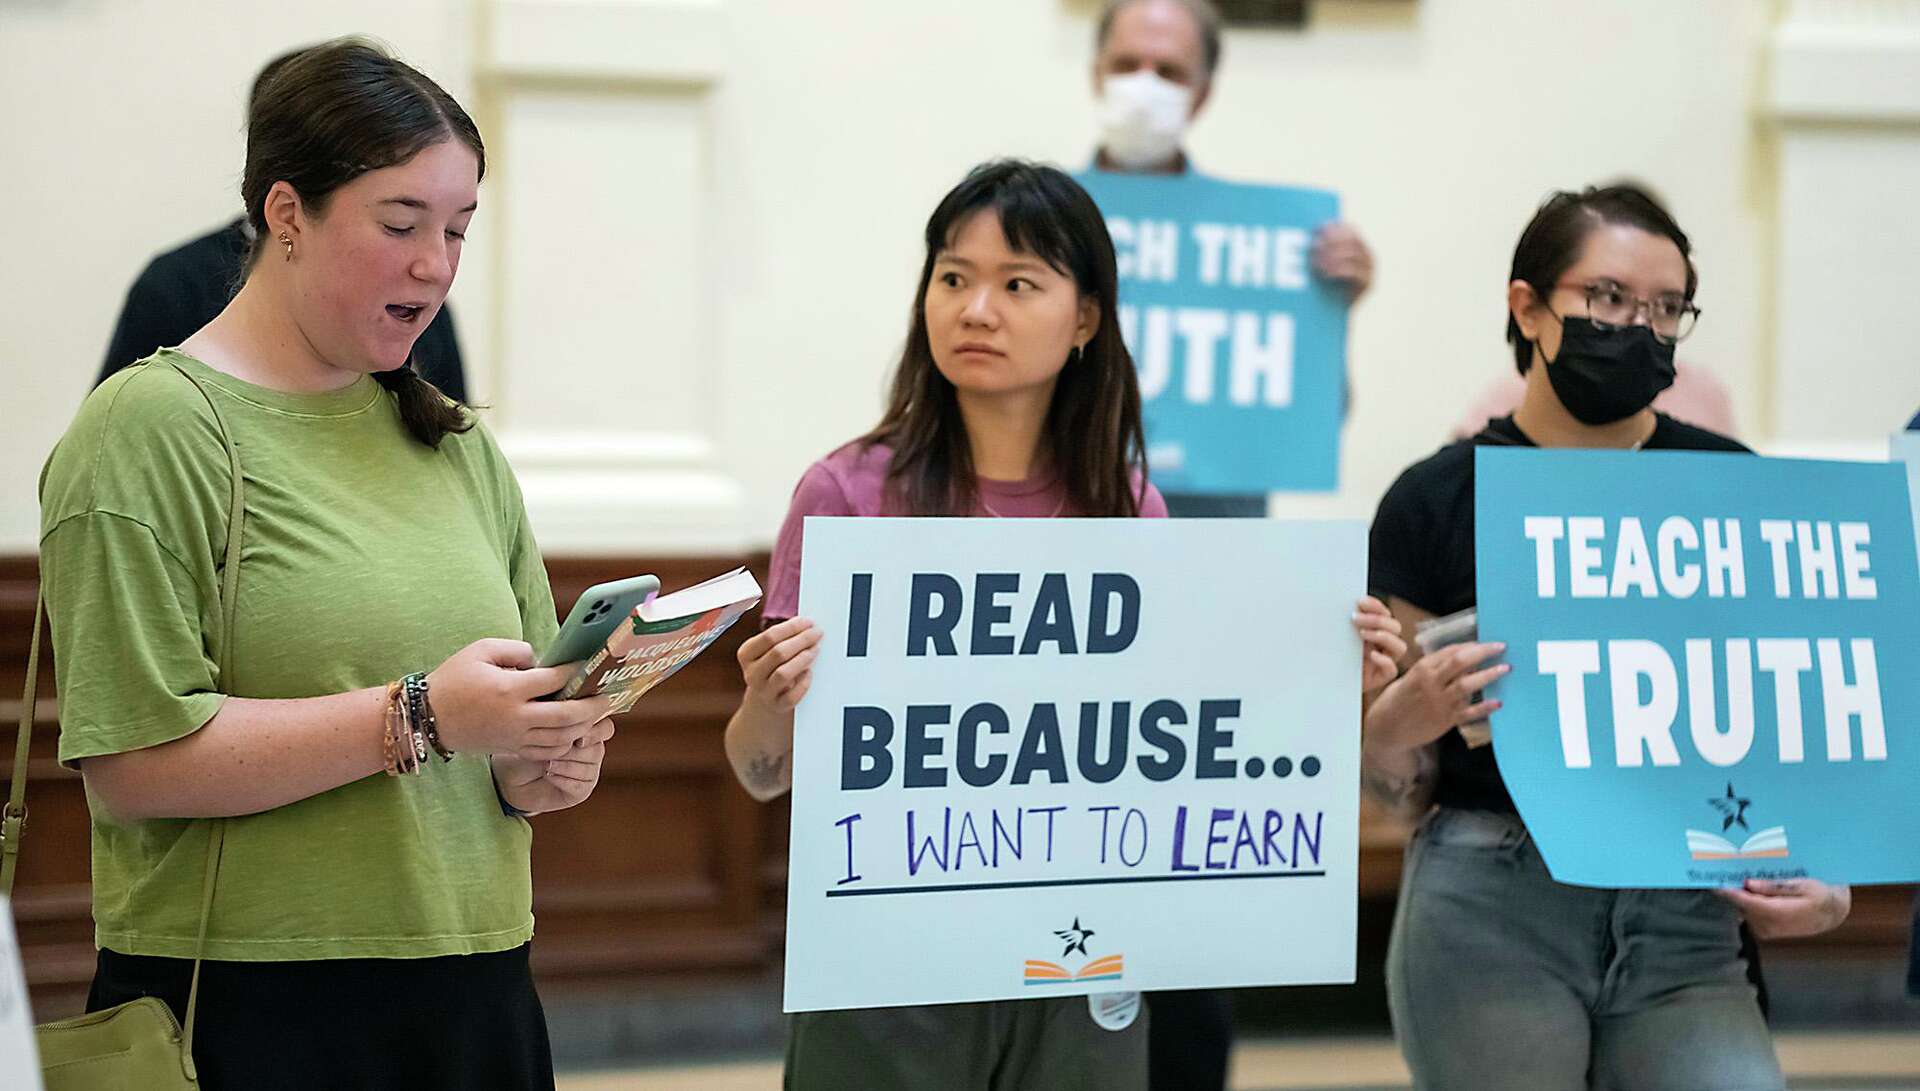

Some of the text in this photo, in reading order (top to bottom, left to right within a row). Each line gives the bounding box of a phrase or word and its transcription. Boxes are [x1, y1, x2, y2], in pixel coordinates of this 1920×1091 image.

[1192, 223, 1308, 289] THE
[1118, 304, 1295, 408] UTH
[1524, 515, 1878, 599] TEACH THE
[846, 573, 1142, 657] I READ
[841, 699, 1322, 790] BECAUSE...
[1537, 638, 1888, 768] TRUTH
[835, 806, 1324, 885] I WANT TO LEARN
